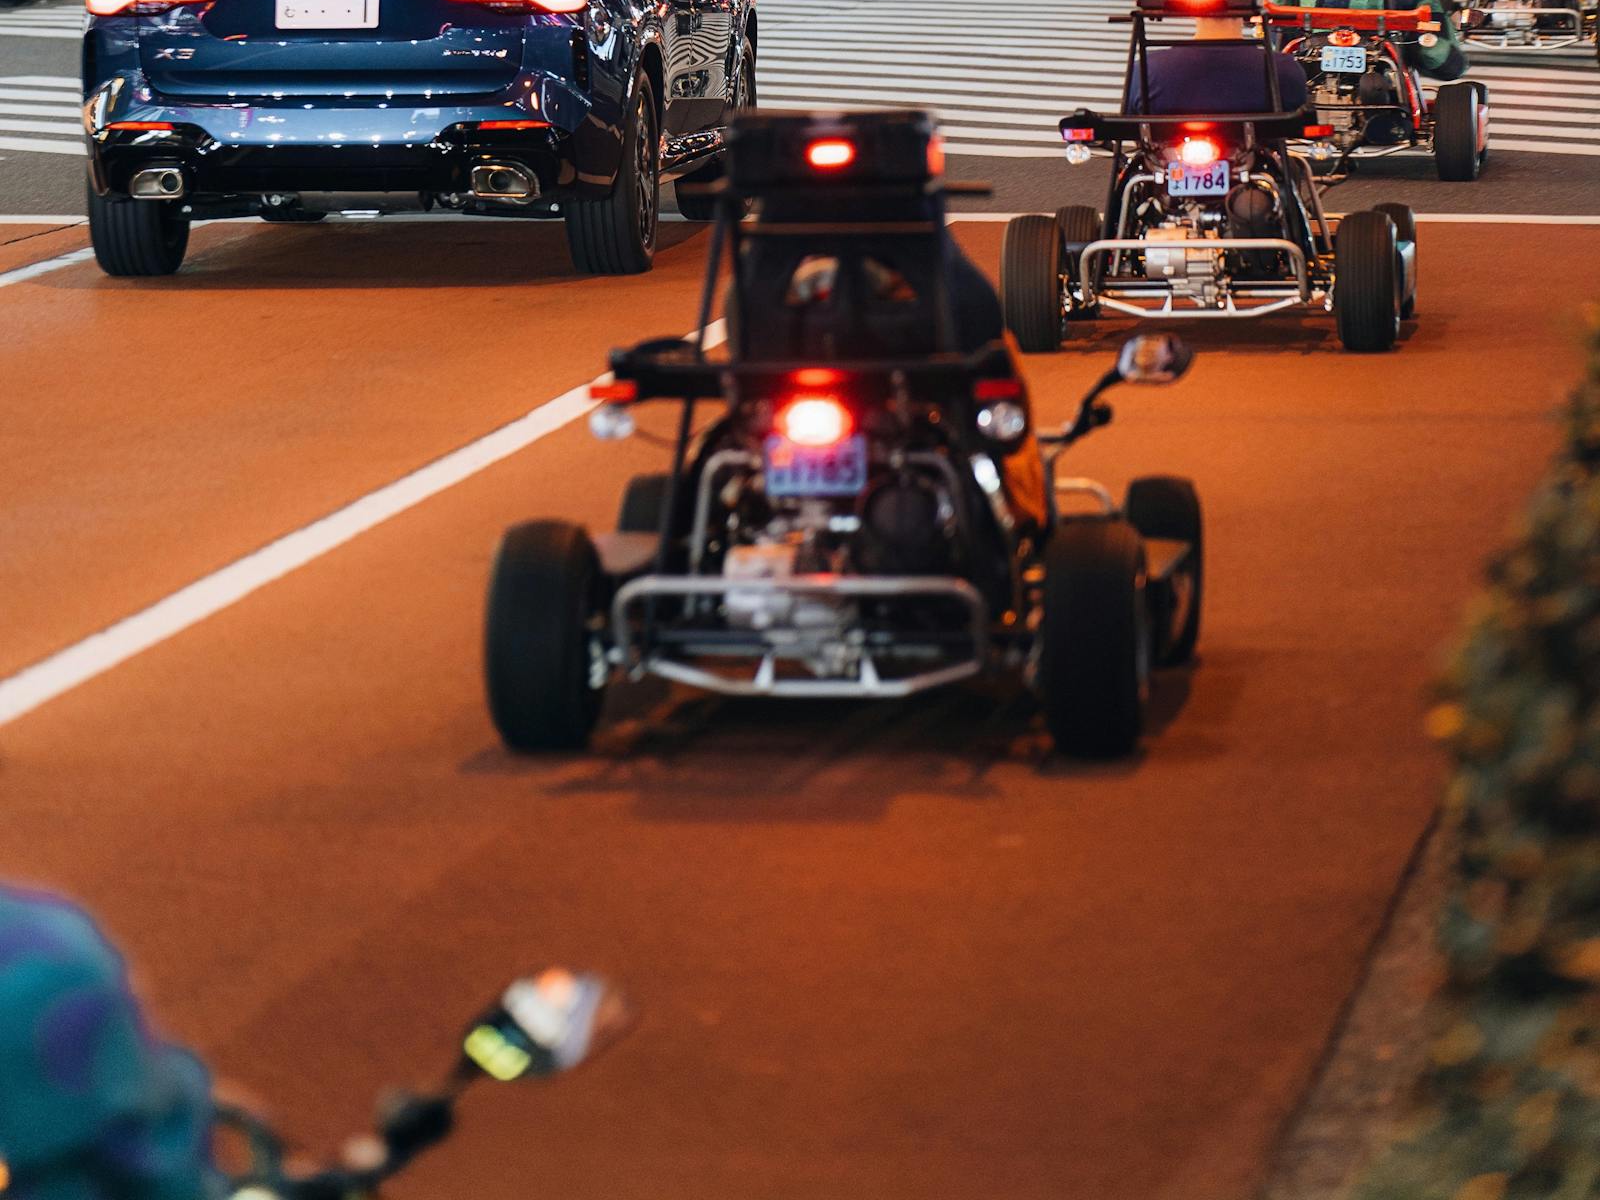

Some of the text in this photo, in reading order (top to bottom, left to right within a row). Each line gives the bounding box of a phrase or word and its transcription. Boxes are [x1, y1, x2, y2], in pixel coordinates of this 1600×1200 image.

[153, 48, 197, 60] X3
[1333, 55, 1363, 69] 1753
[1184, 172, 1226, 190] 1784
